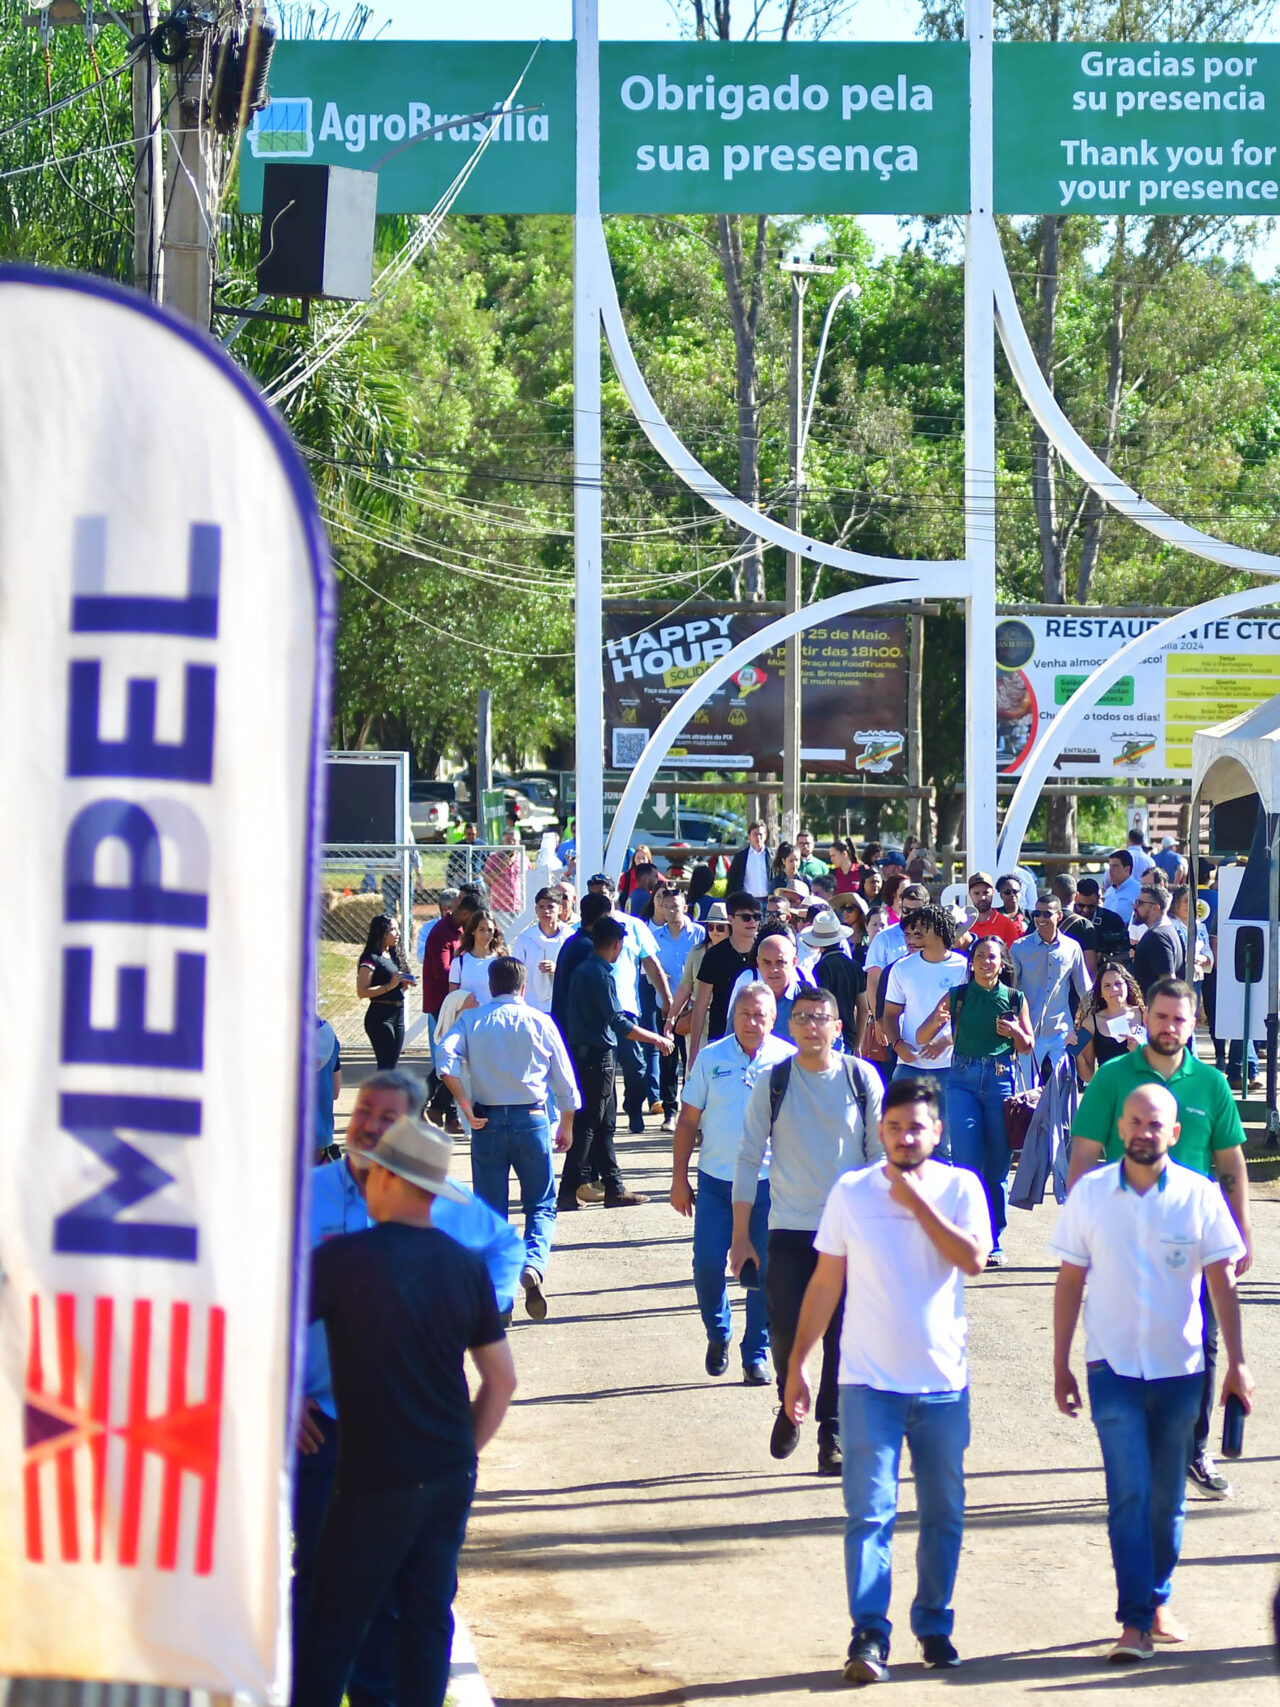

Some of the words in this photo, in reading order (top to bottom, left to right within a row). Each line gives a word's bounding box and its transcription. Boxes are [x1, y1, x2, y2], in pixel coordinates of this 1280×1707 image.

[1081, 50, 1195, 76] Gracias
[1204, 56, 1257, 83] por
[620, 73, 833, 120] Obrigado
[842, 73, 933, 119] pela
[1072, 90, 1106, 110] su
[1116, 85, 1265, 117] presencia
[319, 101, 550, 152] AgroBrasília
[635, 144, 710, 171] sua
[722, 143, 919, 181] presença
[1061, 139, 1159, 166] Thank
[1166, 145, 1223, 172] you
[1231, 139, 1277, 165] for
[1059, 180, 1130, 206] your
[1139, 179, 1279, 206] presence
[606, 614, 734, 659] HAPPY
[808, 629, 828, 640] 25
[830, 629, 849, 640] de
[852, 629, 891, 640] Maio.
[1180, 641, 1204, 650] 2024
[612, 638, 733, 683] HOUR
[822, 646, 848, 657] das
[1034, 658, 1067, 669] Venha
[1093, 712, 1121, 721] todos
[1137, 713, 1161, 721] dias!
[52, 515, 221, 1262] MEPEL
